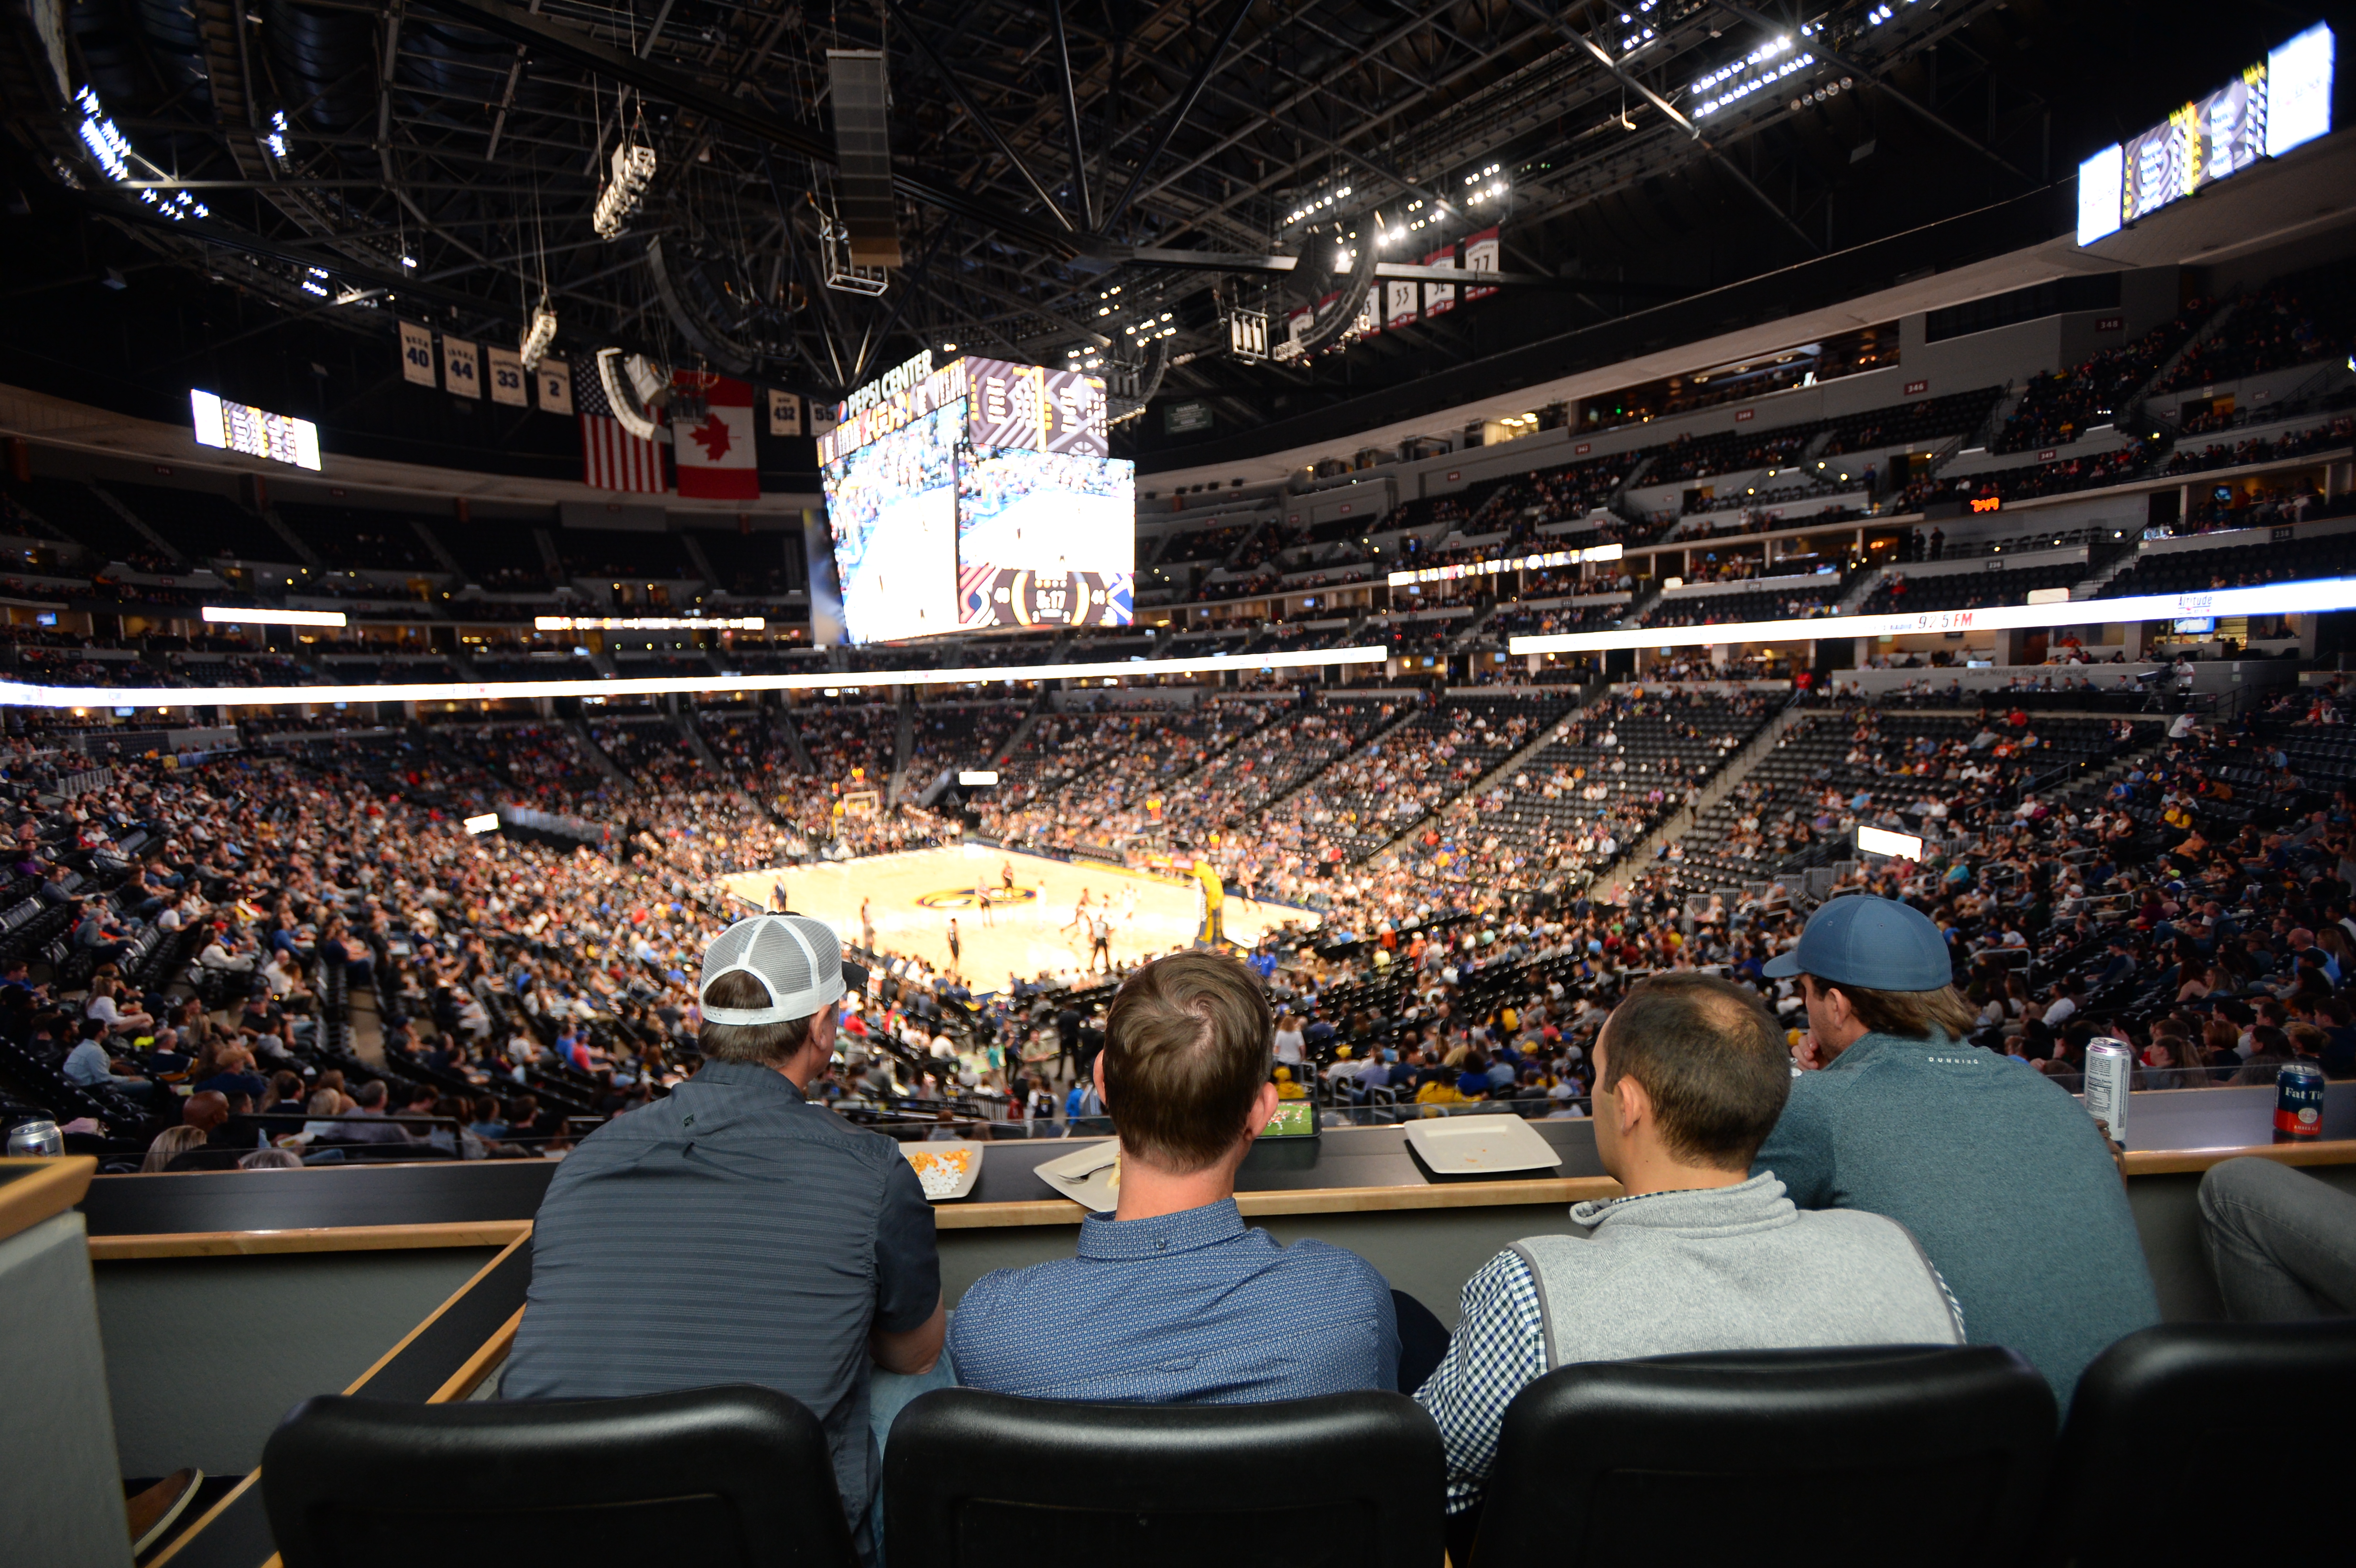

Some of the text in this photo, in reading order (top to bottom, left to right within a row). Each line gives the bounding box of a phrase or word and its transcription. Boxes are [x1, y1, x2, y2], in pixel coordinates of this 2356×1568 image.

[1396, 286, 1409, 307] 33
[2100, 321, 2118, 329] 348
[408, 347, 429, 368] 40
[451, 360, 473, 380] 44
[497, 370, 519, 388] 33
[848, 379, 882, 419] PEPSI
[882, 348, 934, 400] CENTER
[549, 381, 559, 397] 2
[1909, 383, 1924, 392] 346
[774, 406, 795, 420] 432
[815, 407, 835, 421] 55
[2178, 595, 2212, 606] Altitude
[1954, 613, 1973, 627] FM
[2285, 1087, 2323, 1100] Fat Tir
